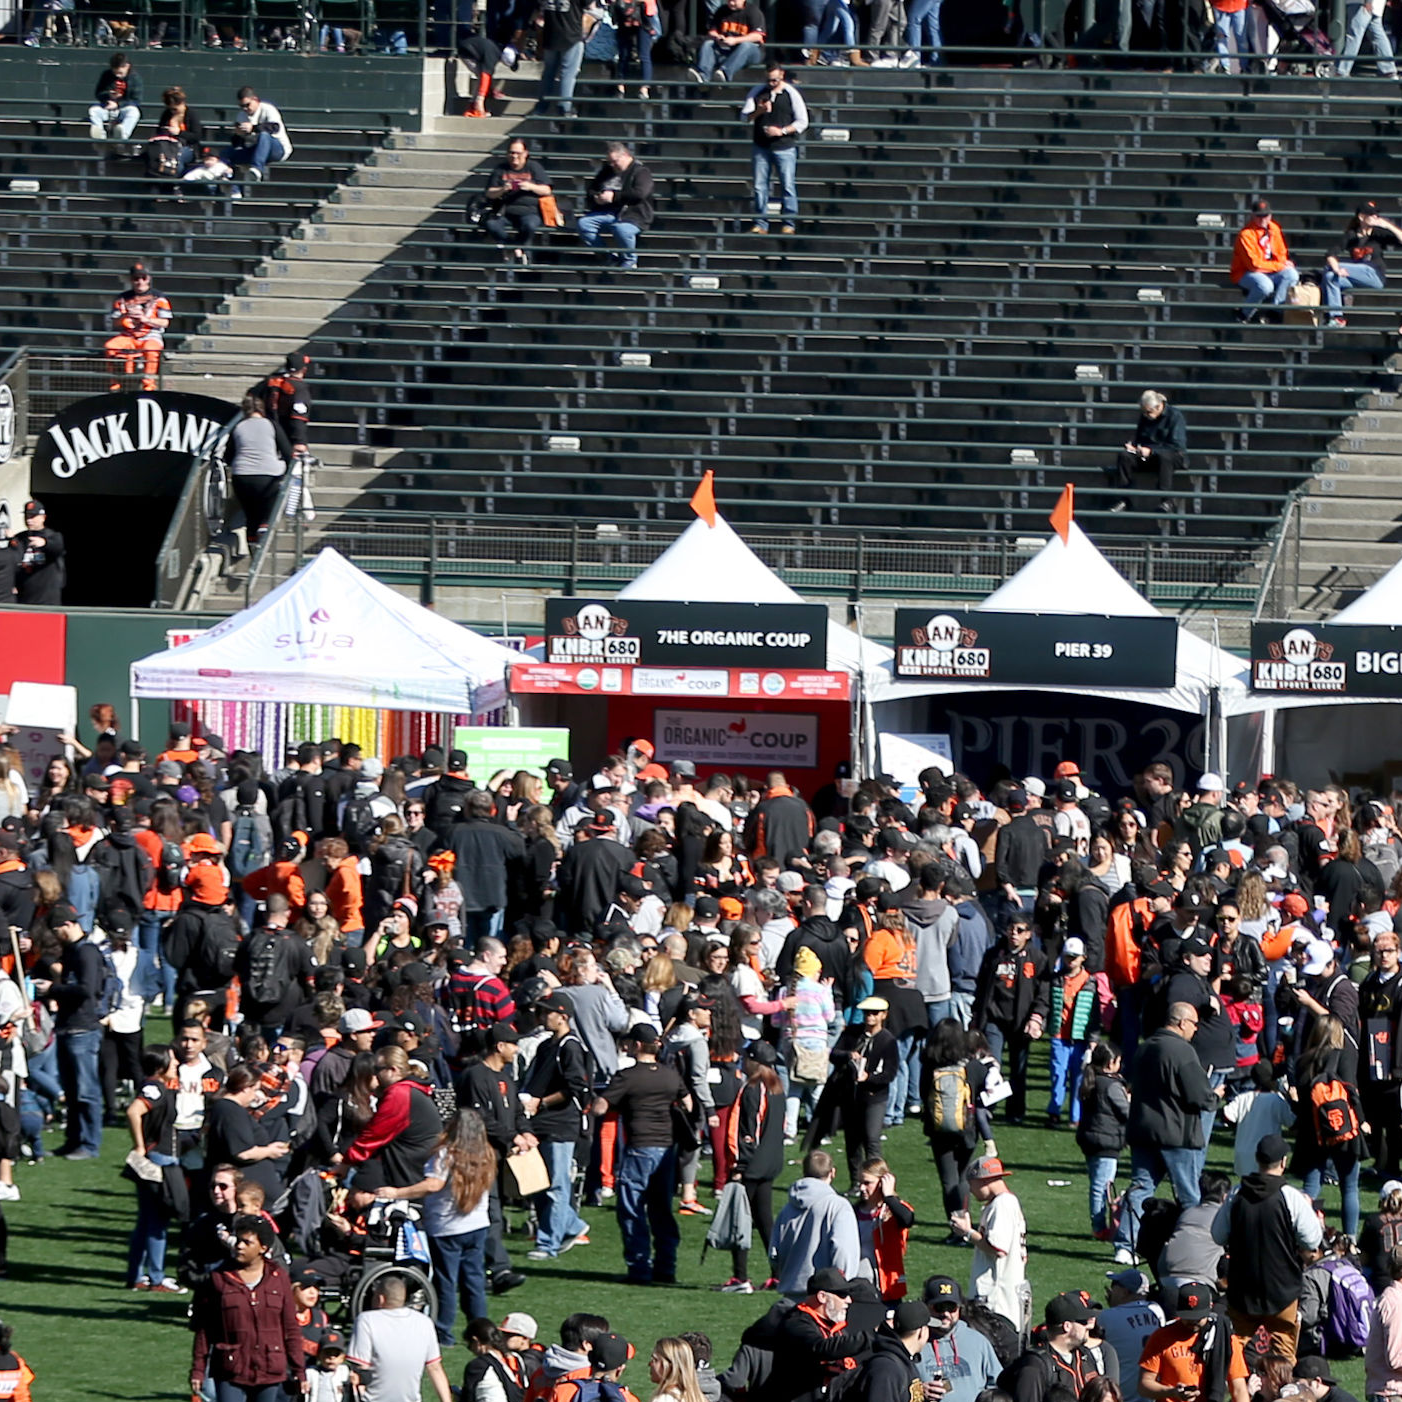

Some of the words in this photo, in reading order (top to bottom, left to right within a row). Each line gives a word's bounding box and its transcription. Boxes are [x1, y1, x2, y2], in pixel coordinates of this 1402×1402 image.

[48, 412, 136, 478] JACK
[136, 398, 229, 462] DANI
[561, 614, 628, 636] GIANTS
[274, 629, 355, 650] suja
[690, 631, 763, 647] ORGANIC
[765, 632, 811, 648] COUP
[912, 626, 978, 647] GIANTS
[551, 637, 604, 656] KNBR
[607, 640, 637, 656] 680
[1055, 642, 1090, 658] PIER
[1092, 643, 1113, 659] 39
[1268, 641, 1334, 661] GIANTS
[901, 648, 953, 667] KNBR
[957, 651, 986, 666] 680
[1258, 662, 1309, 681] KNBR
[1313, 663, 1342, 680] 680
[688, 680, 722, 690] COUP
[664, 727, 727, 747] ORGANIC
[750, 732, 808, 749] COUP
[1326, 1107, 1345, 1132] SF
[938, 1283, 953, 1296] M
[1127, 1312, 1156, 1329] PENC
